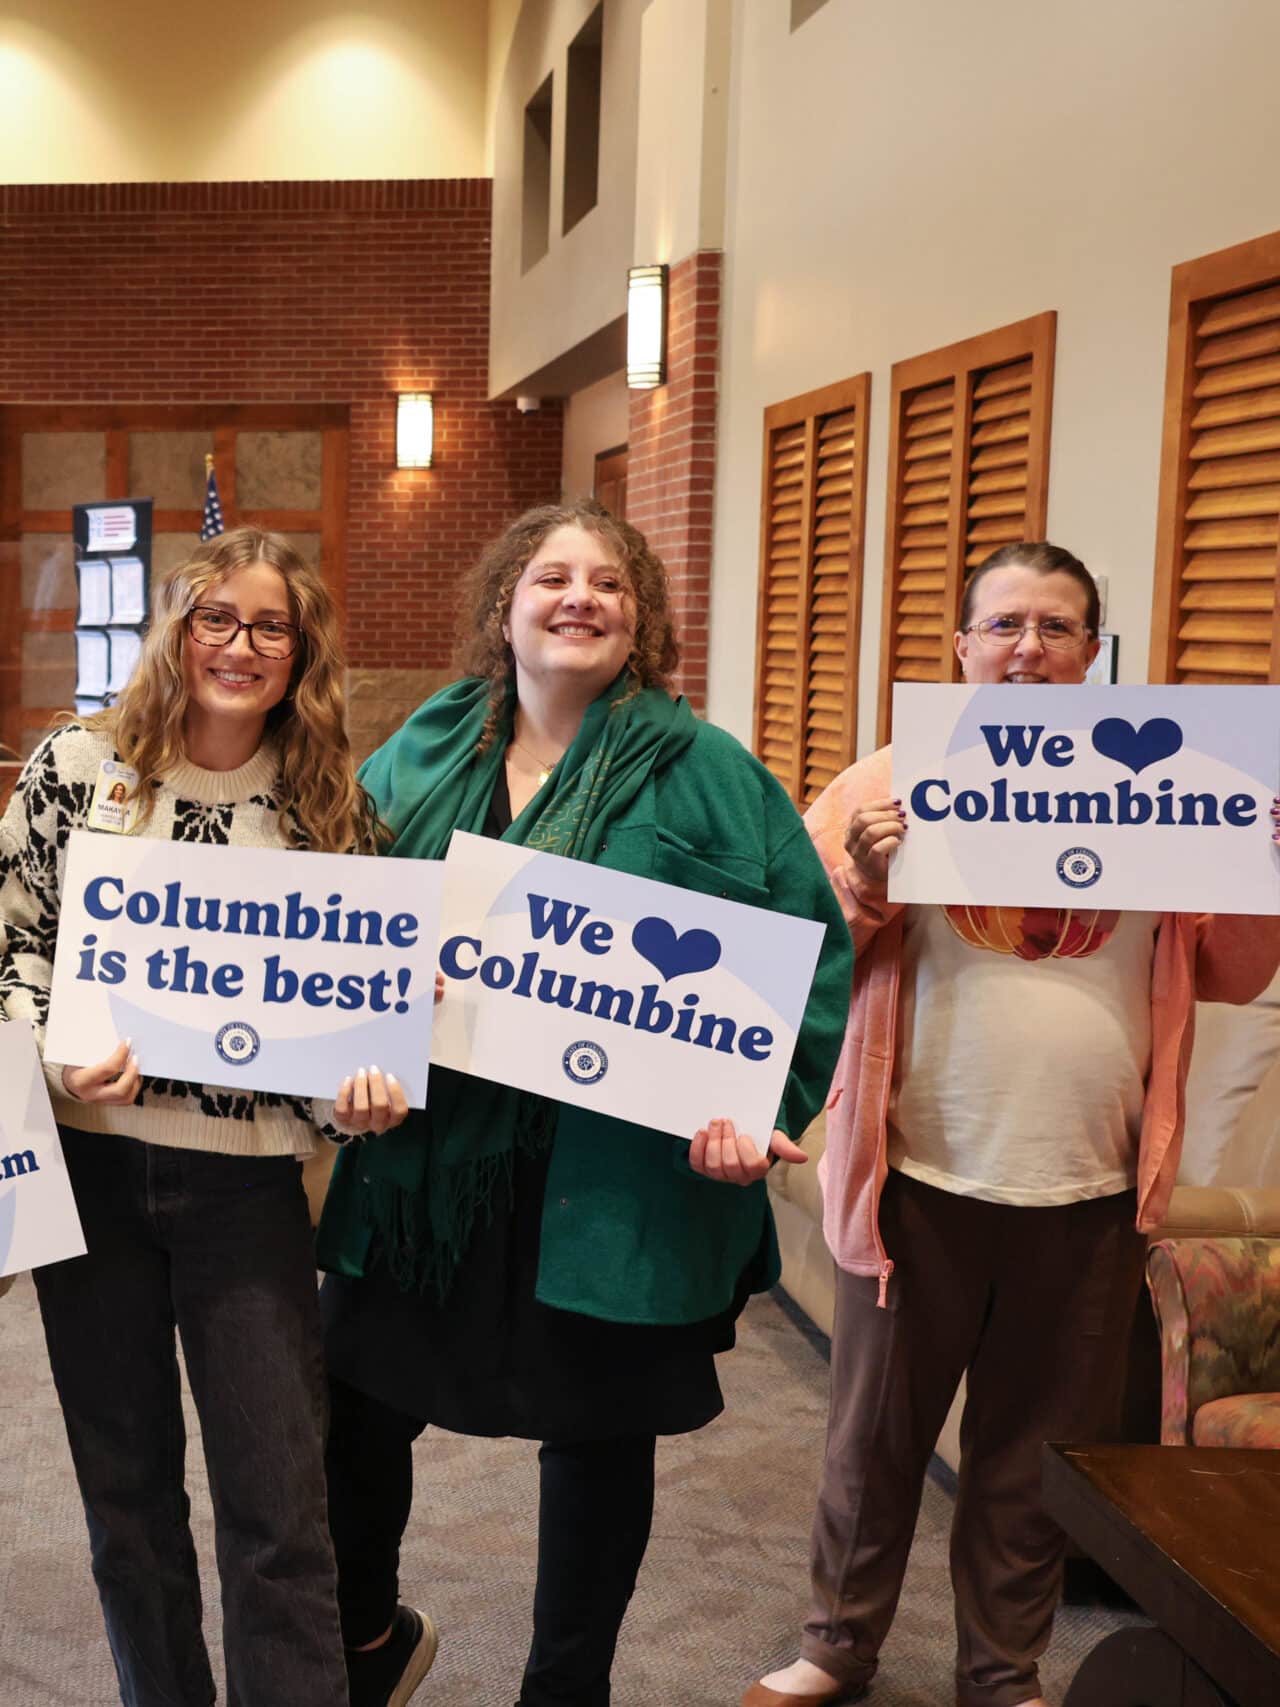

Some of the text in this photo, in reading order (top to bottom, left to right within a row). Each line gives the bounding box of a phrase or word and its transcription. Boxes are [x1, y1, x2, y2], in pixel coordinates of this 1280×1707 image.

[980, 725, 1074, 767] We
[97, 803, 131, 816] MAKAYA
[911, 778, 1257, 827] Columbine
[84, 876, 419, 948] Columbine
[527, 893, 614, 955] We
[76, 934, 412, 1015] is the best!
[439, 935, 774, 1062] Columbine
